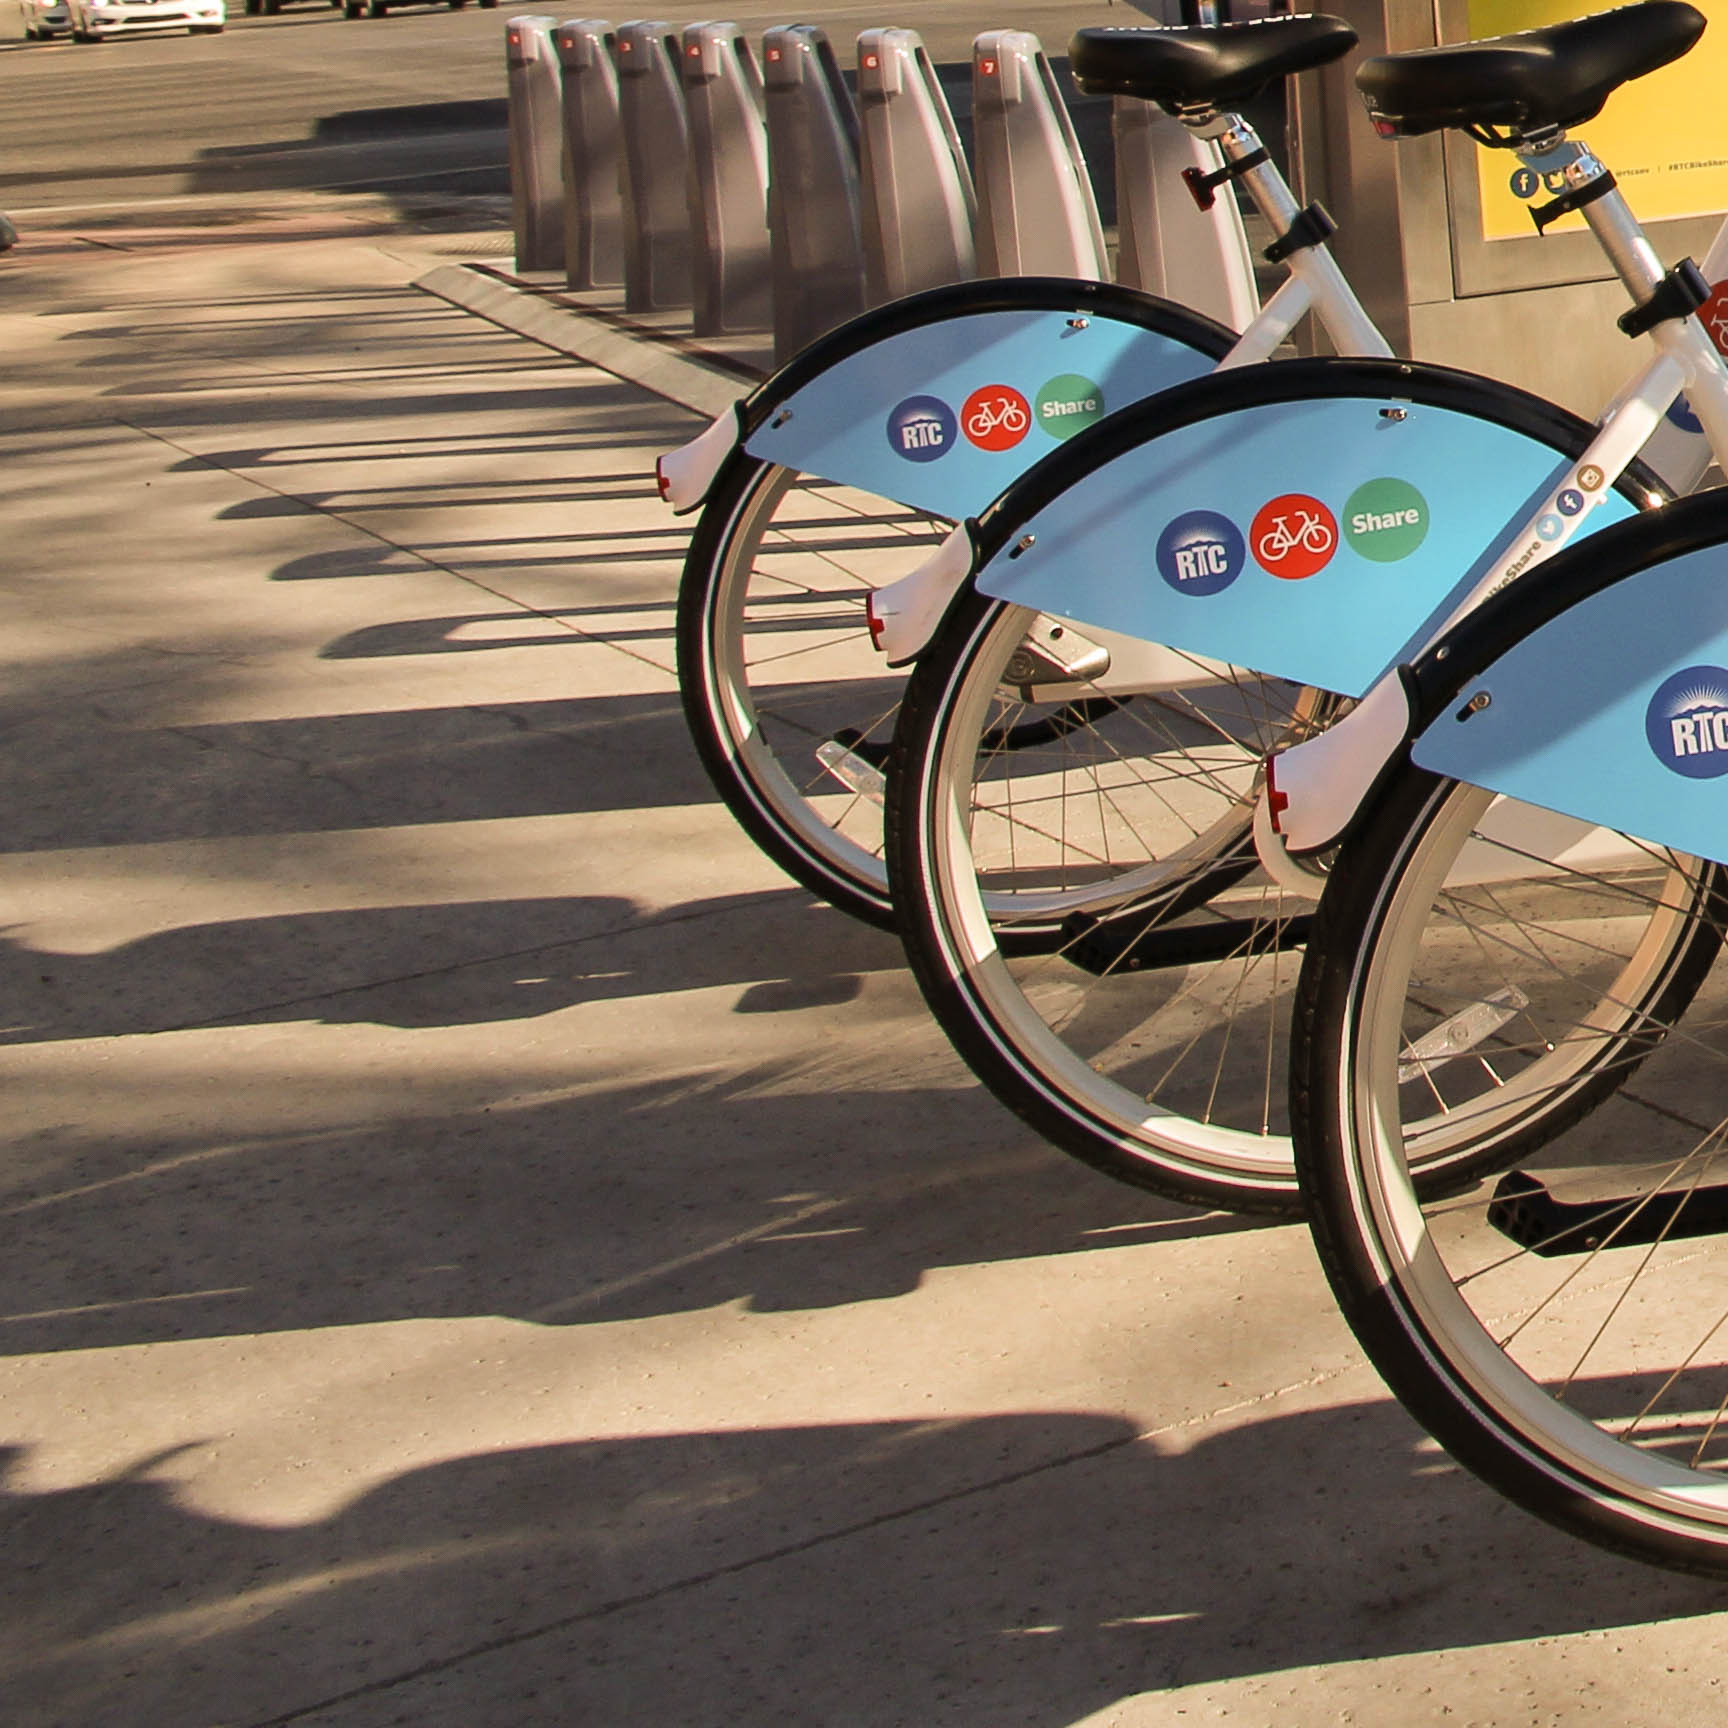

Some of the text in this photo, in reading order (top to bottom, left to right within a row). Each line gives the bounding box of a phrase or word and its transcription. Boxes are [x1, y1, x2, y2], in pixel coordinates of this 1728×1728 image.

[690, 47, 699, 56] 4
[867, 56, 877, 67] 6
[984, 62, 994, 74] 7
[902, 398, 1097, 450] RTC Share
[1175, 506, 1420, 581] RTC Share
